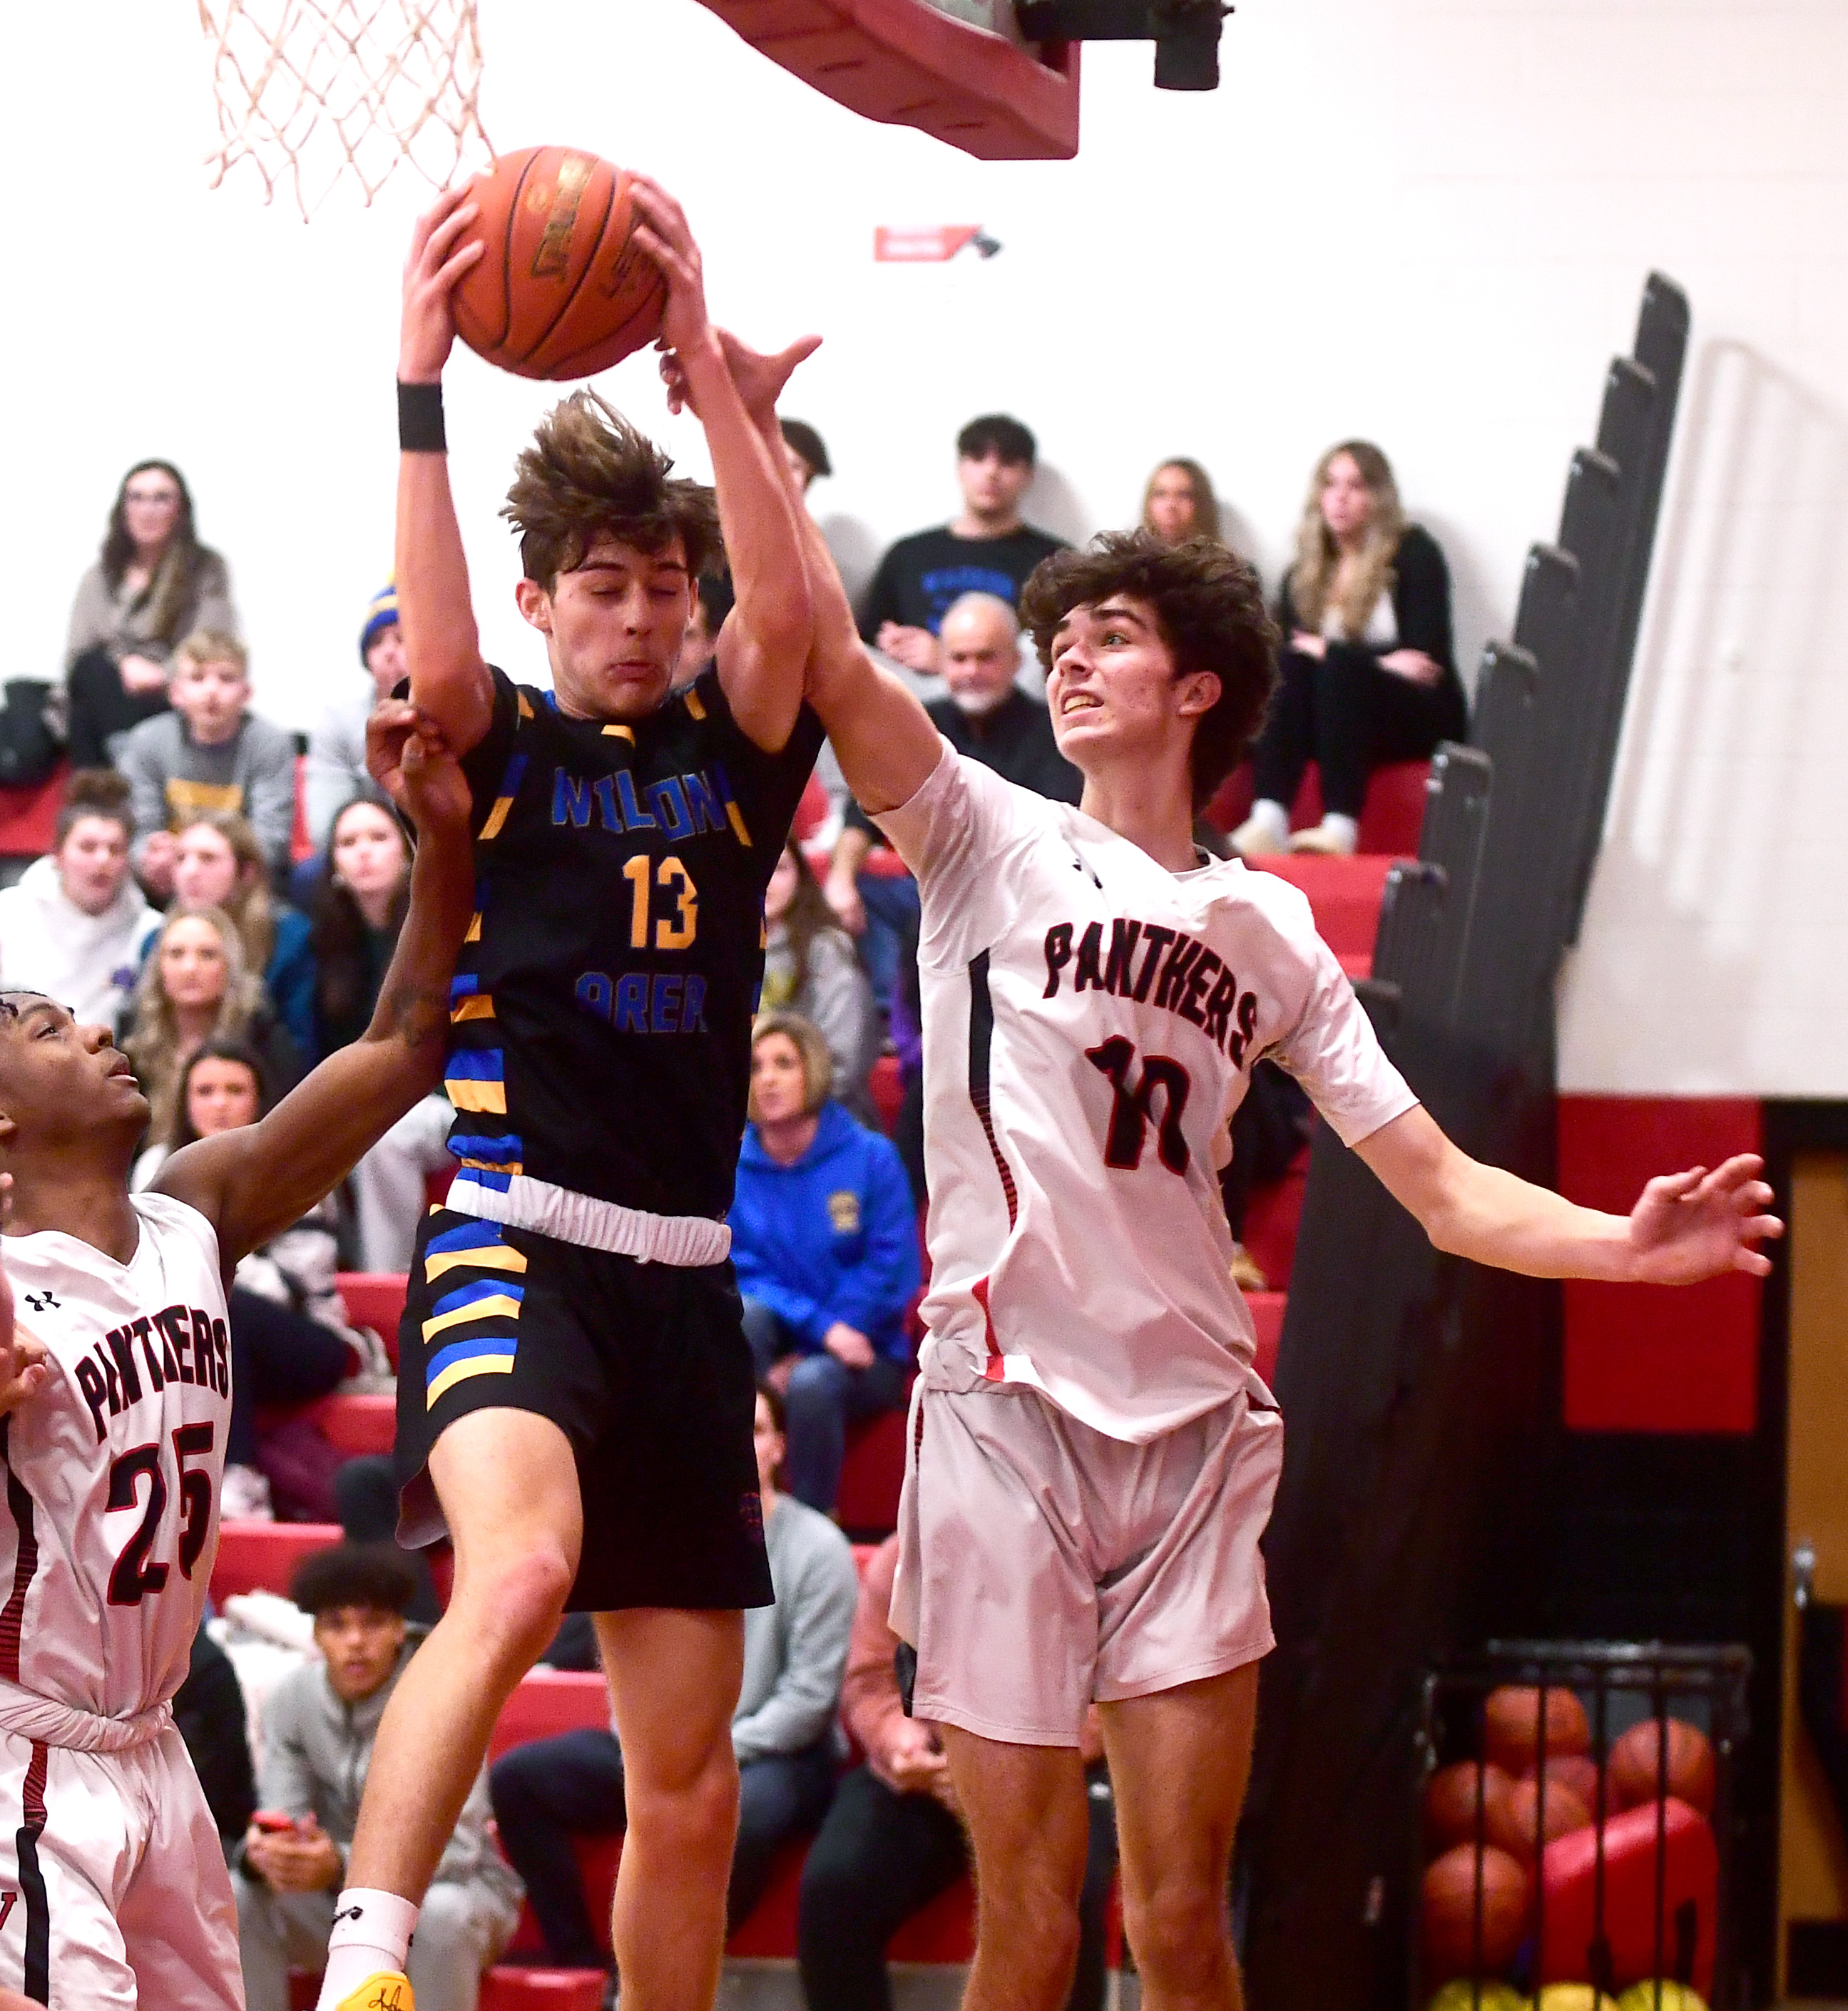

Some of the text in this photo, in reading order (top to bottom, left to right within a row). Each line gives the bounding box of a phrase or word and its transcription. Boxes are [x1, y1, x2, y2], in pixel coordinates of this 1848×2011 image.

[623, 854, 698, 950] 13
[1043, 918, 1257, 1071] PANTHERS
[1085, 1034, 1190, 1176] 10
[105, 1421, 213, 1605] 25
